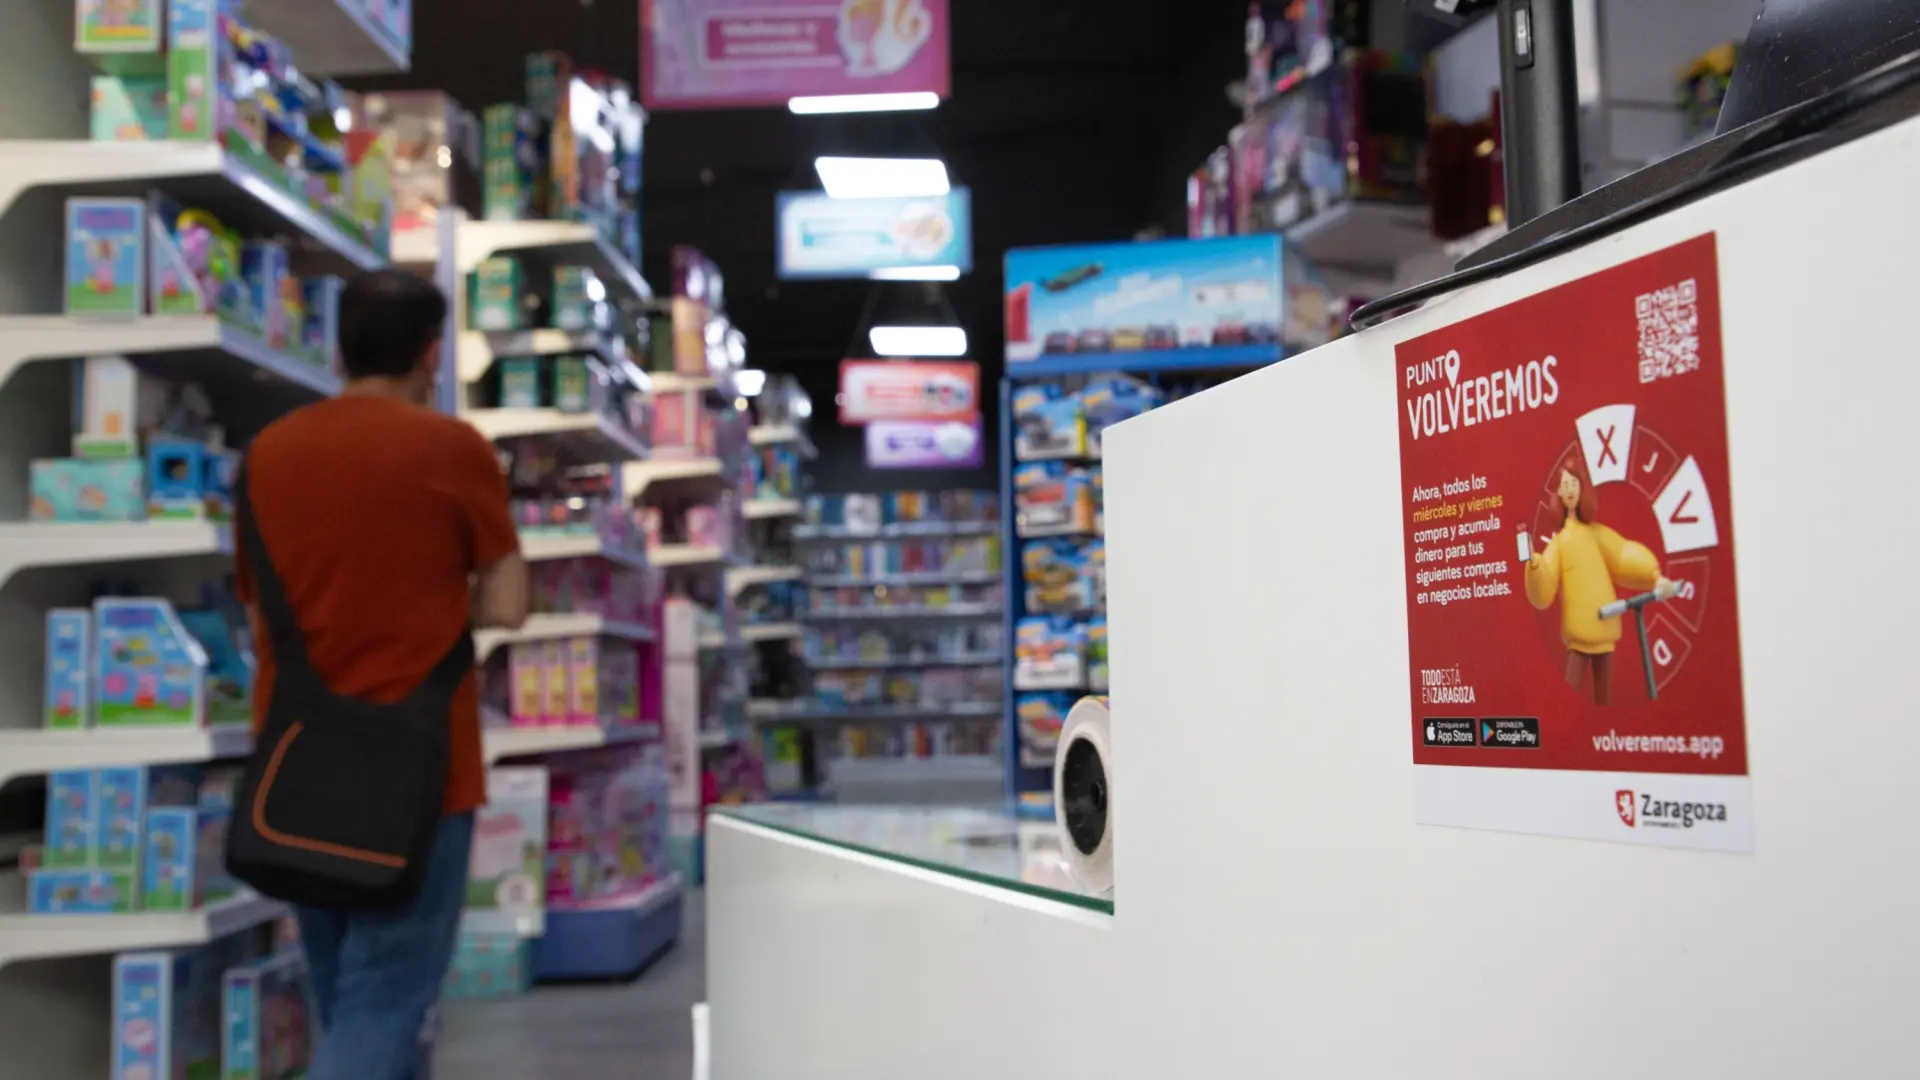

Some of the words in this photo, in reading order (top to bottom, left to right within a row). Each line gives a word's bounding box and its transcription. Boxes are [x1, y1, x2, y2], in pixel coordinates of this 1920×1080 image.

[1407, 355, 1559, 440] VOLVEREMOS
[1596, 424, 1618, 468] X
[1412, 485, 1442, 502] Ahora,
[1443, 477, 1470, 496] todos
[1471, 474, 1487, 490] los
[1413, 502, 1457, 523] miércoles
[1459, 503, 1465, 518] y
[1467, 495, 1503, 513] viernes
[1414, 527, 1449, 543] compra
[1450, 526, 1457, 542] y
[1458, 514, 1500, 536] acumula
[1415, 548, 1443, 564] dinero
[1445, 545, 1466, 563] para
[1468, 541, 1484, 555] tus
[1416, 566, 1462, 586] siguientes
[1463, 561, 1507, 579] compras
[1417, 592, 1429, 604] en
[1430, 584, 1471, 605] negocios
[1473, 579, 1512, 598] locales.
[1437, 730, 1452, 744] App
[1453, 729, 1473, 742] Store
[1496, 729, 1521, 744] Google
[1521, 729, 1537, 745] Play
[1592, 729, 1724, 759] volveremos.app
[1641, 794, 1727, 828] Zaragoza
